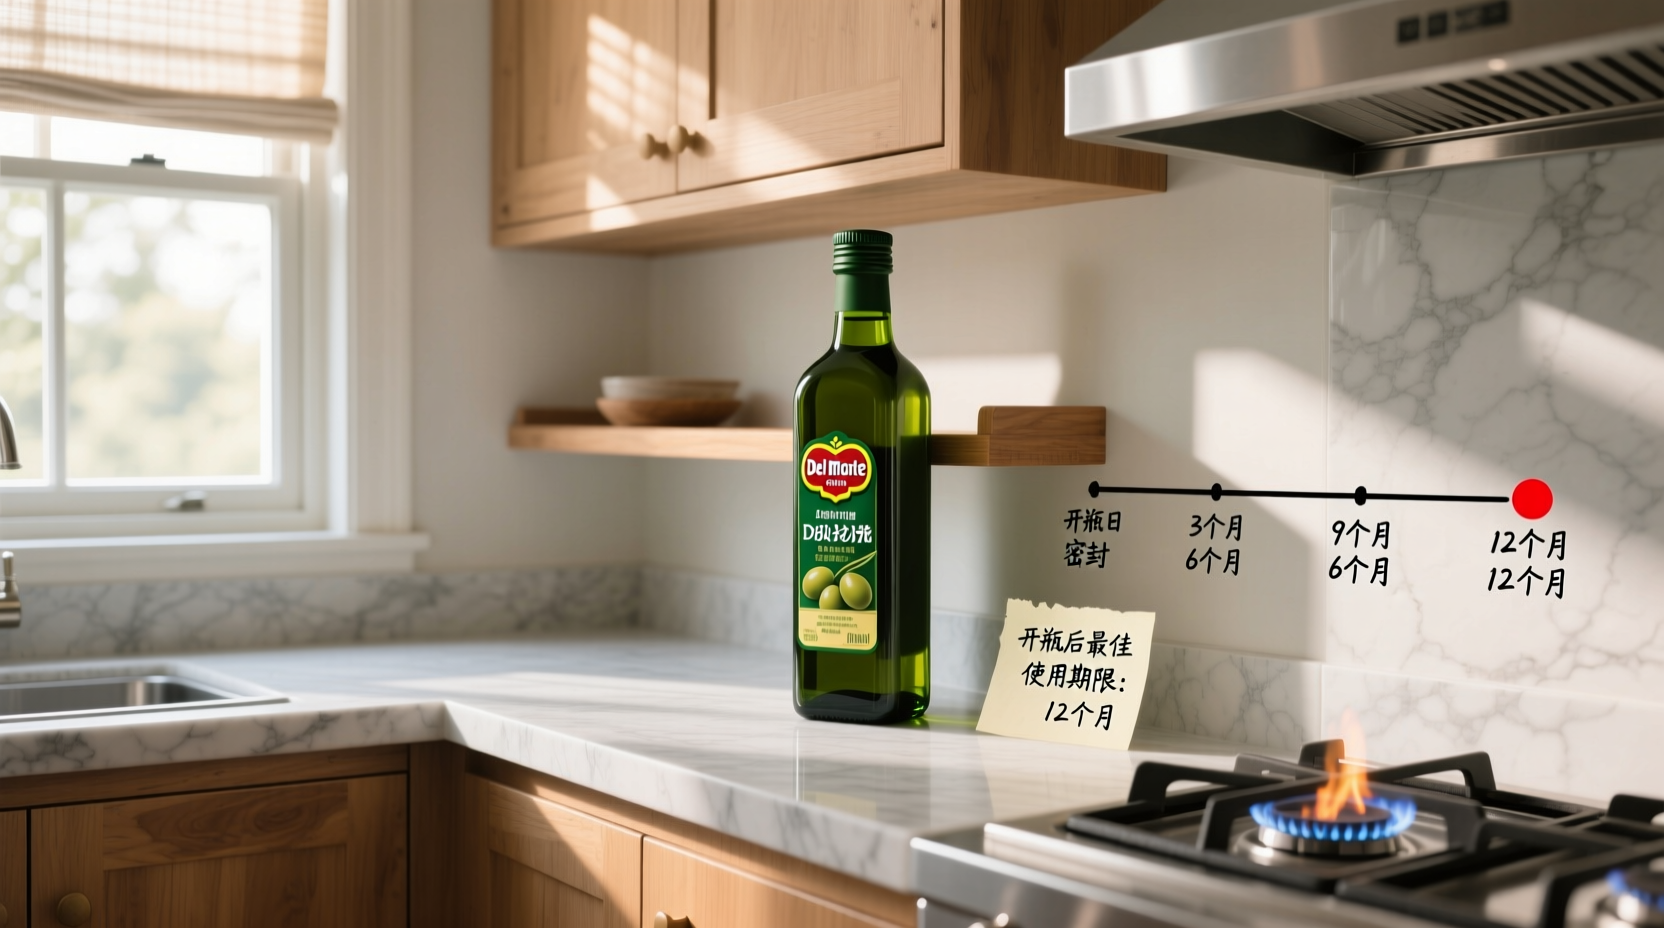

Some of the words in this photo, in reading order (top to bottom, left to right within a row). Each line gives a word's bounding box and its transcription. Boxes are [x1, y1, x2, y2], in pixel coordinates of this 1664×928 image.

[807, 459, 826, 476] Del
[1018, 628, 1133, 659] 开瓶后最佳
[1044, 702, 1114, 732] 12个月
